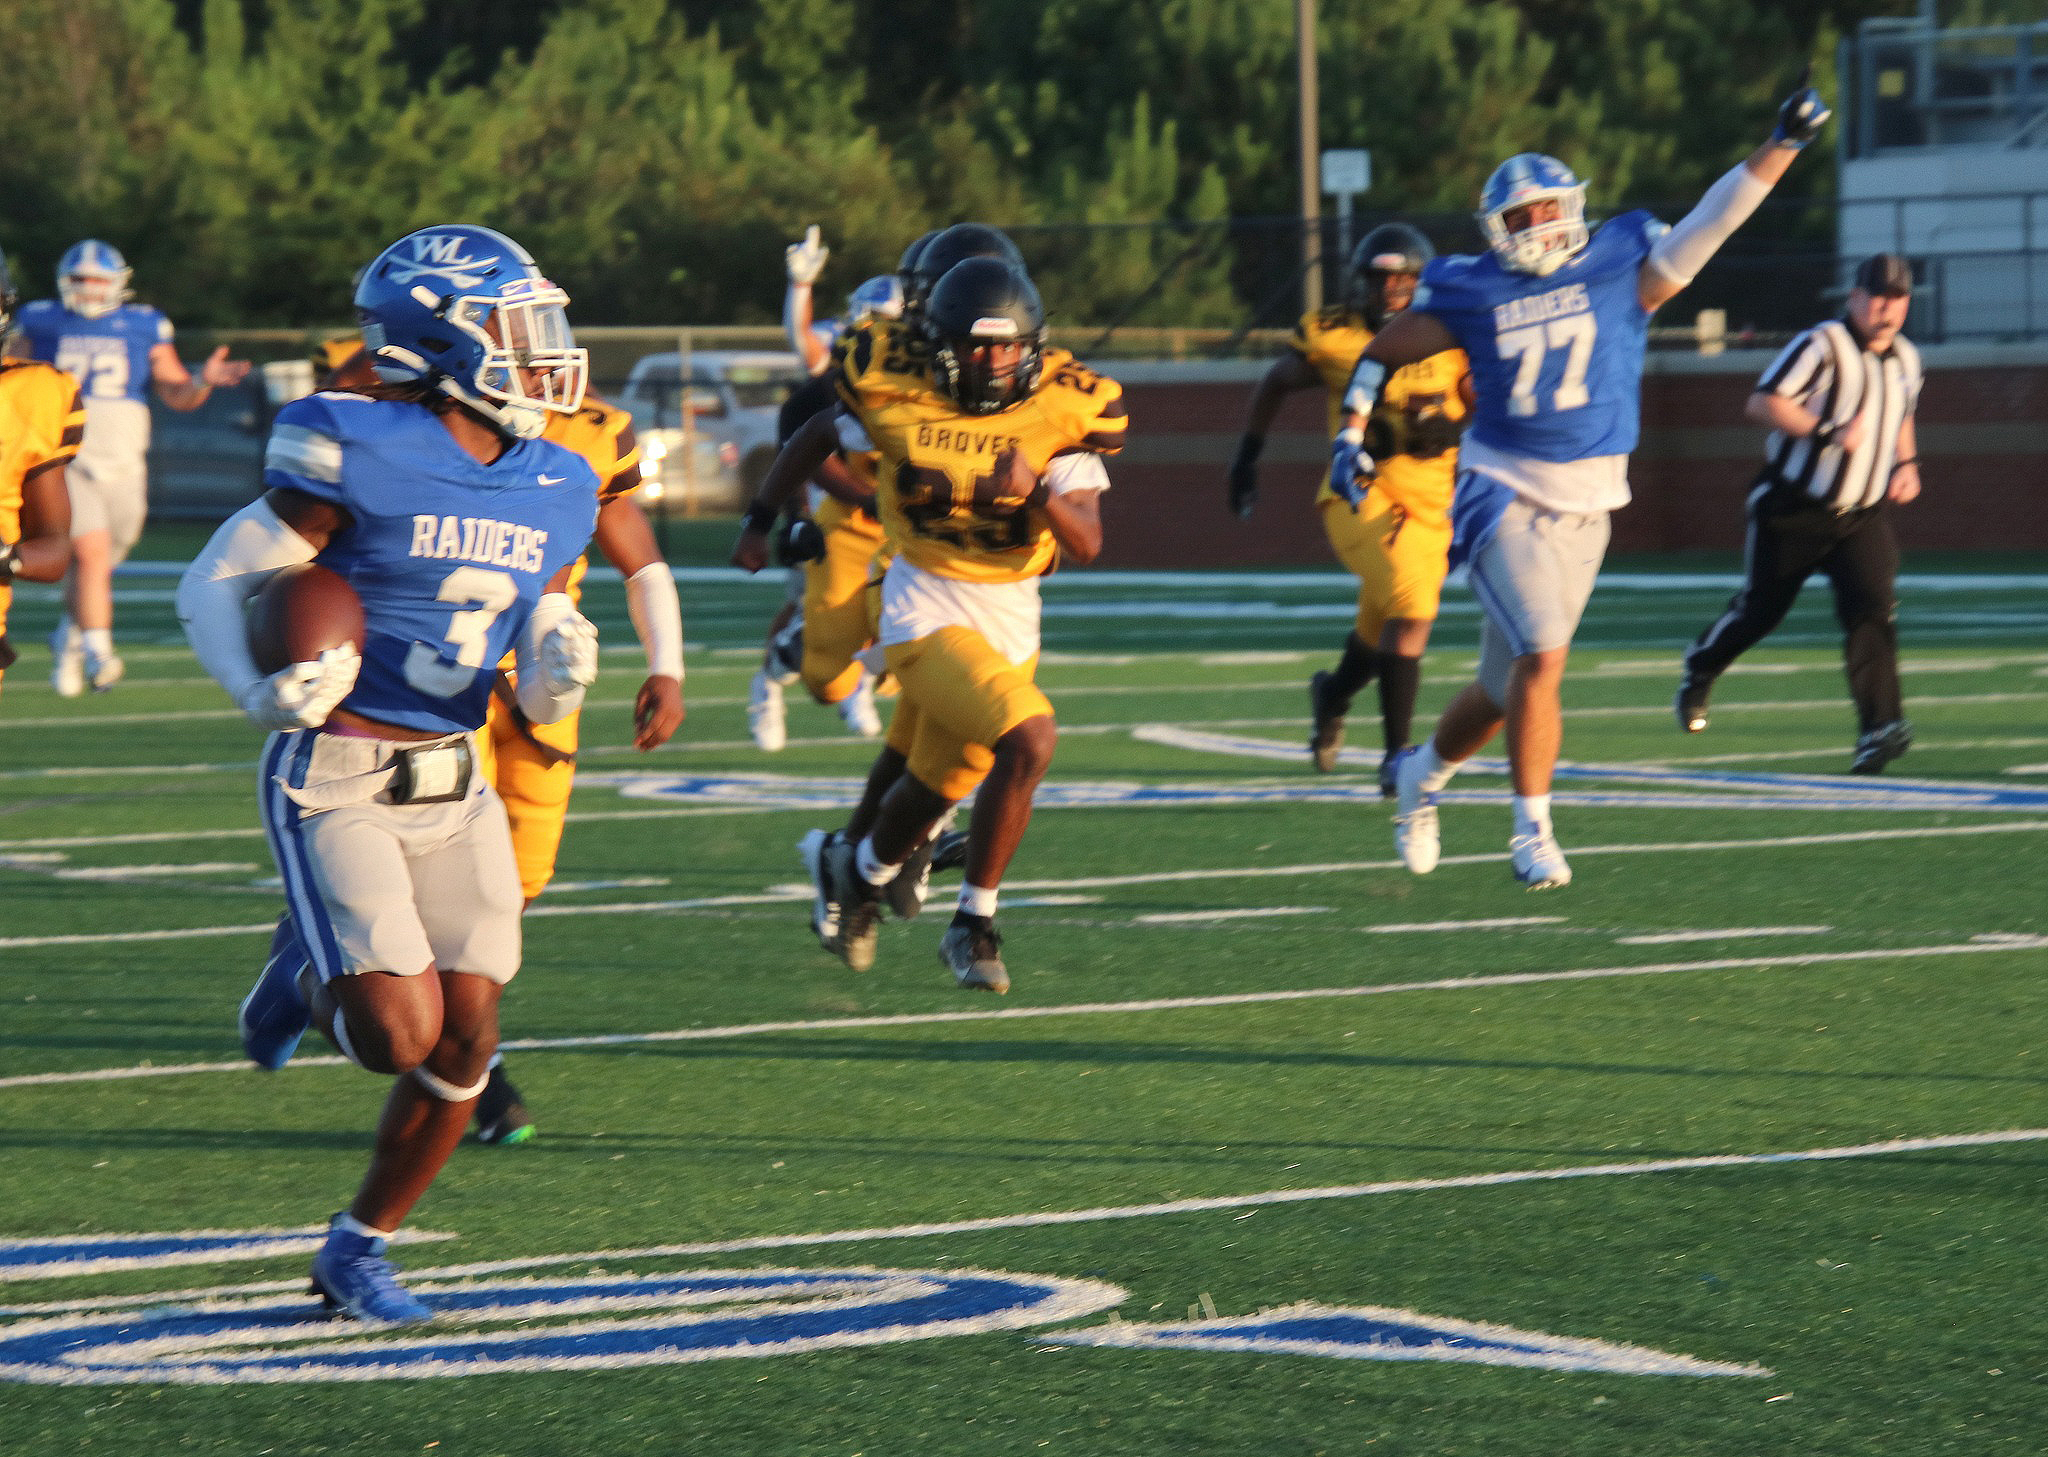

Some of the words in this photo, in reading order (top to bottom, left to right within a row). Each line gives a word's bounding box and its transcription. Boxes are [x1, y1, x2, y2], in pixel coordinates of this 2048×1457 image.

[412, 235, 473, 265] WL
[56, 353, 130, 398] 72
[1496, 311, 1598, 416] 77
[409, 514, 549, 574] RAIDERS
[403, 565, 519, 698] 3
